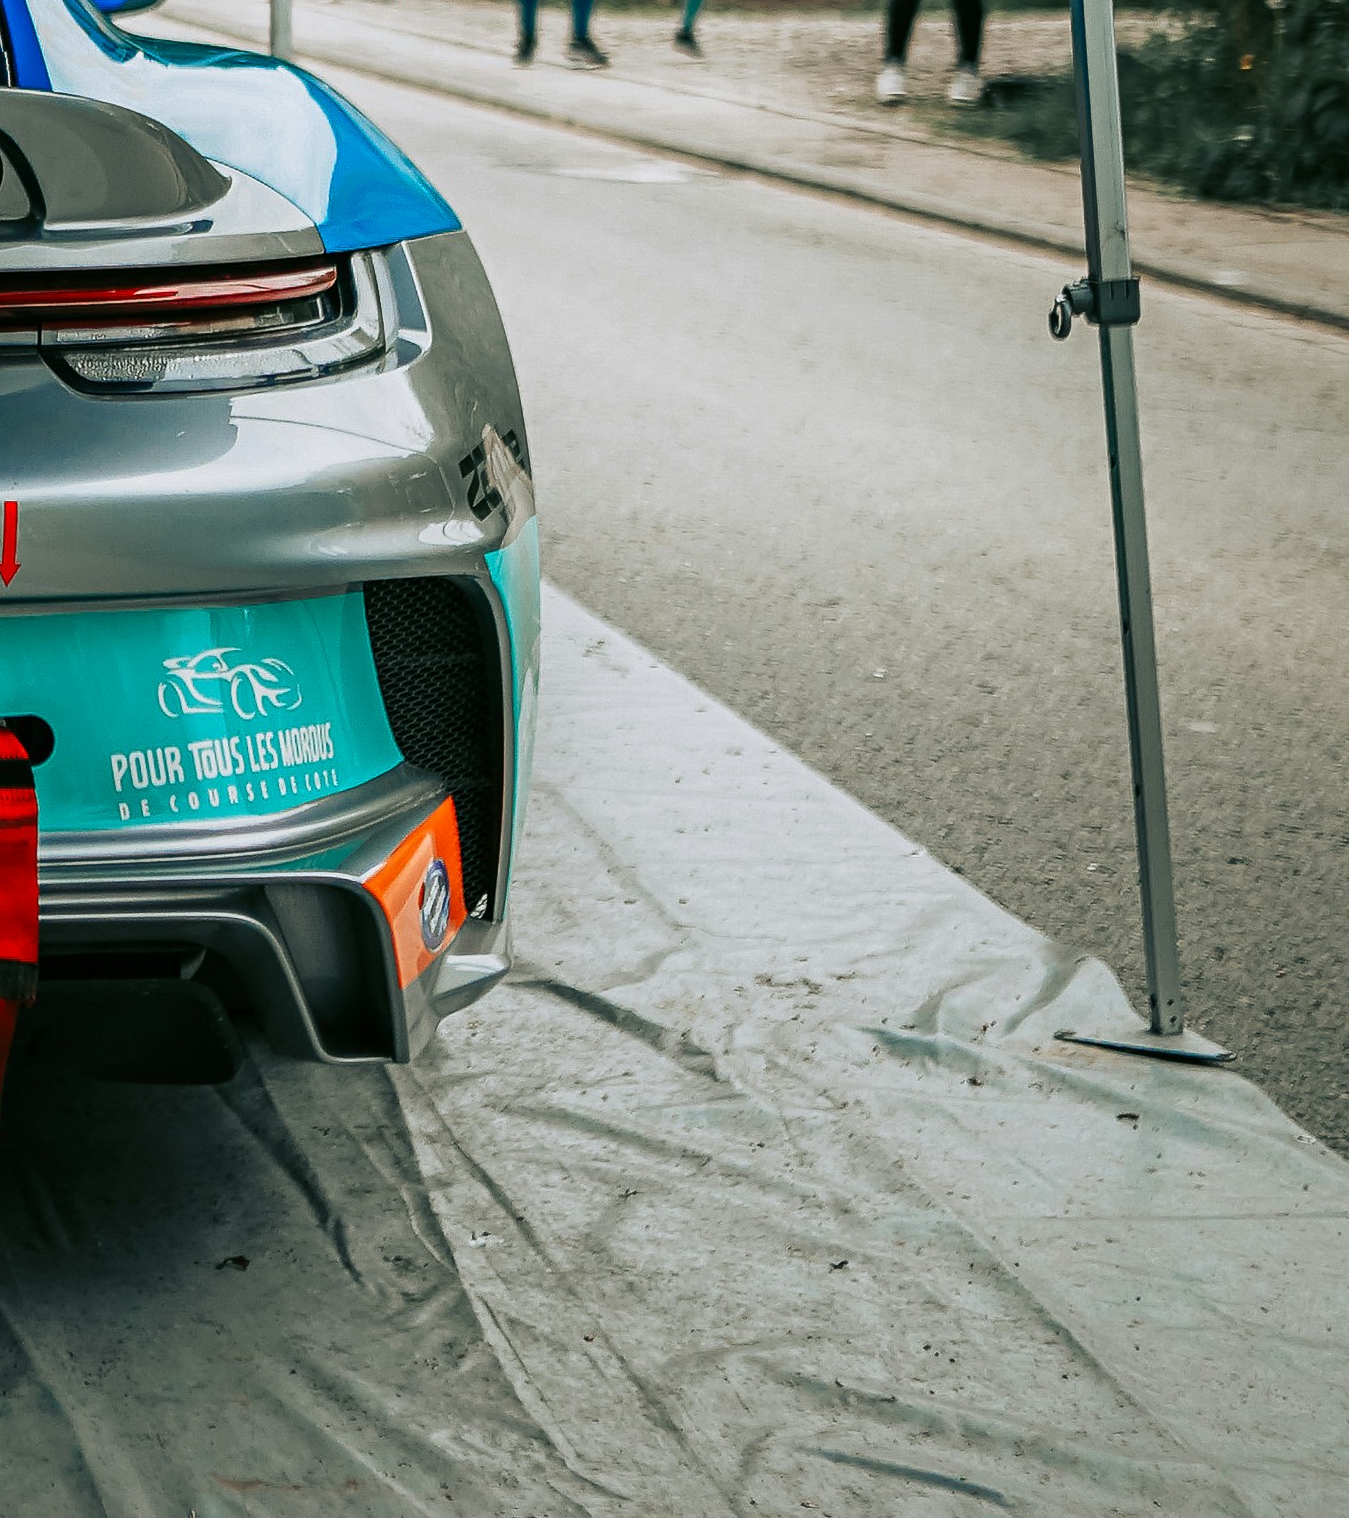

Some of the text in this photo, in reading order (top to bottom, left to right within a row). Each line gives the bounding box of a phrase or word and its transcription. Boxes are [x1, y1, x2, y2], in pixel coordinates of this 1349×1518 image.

[110, 721, 335, 792] POUR TOUS LES MORDUS
[118, 768, 339, 821] DE COURSE DE COTE
